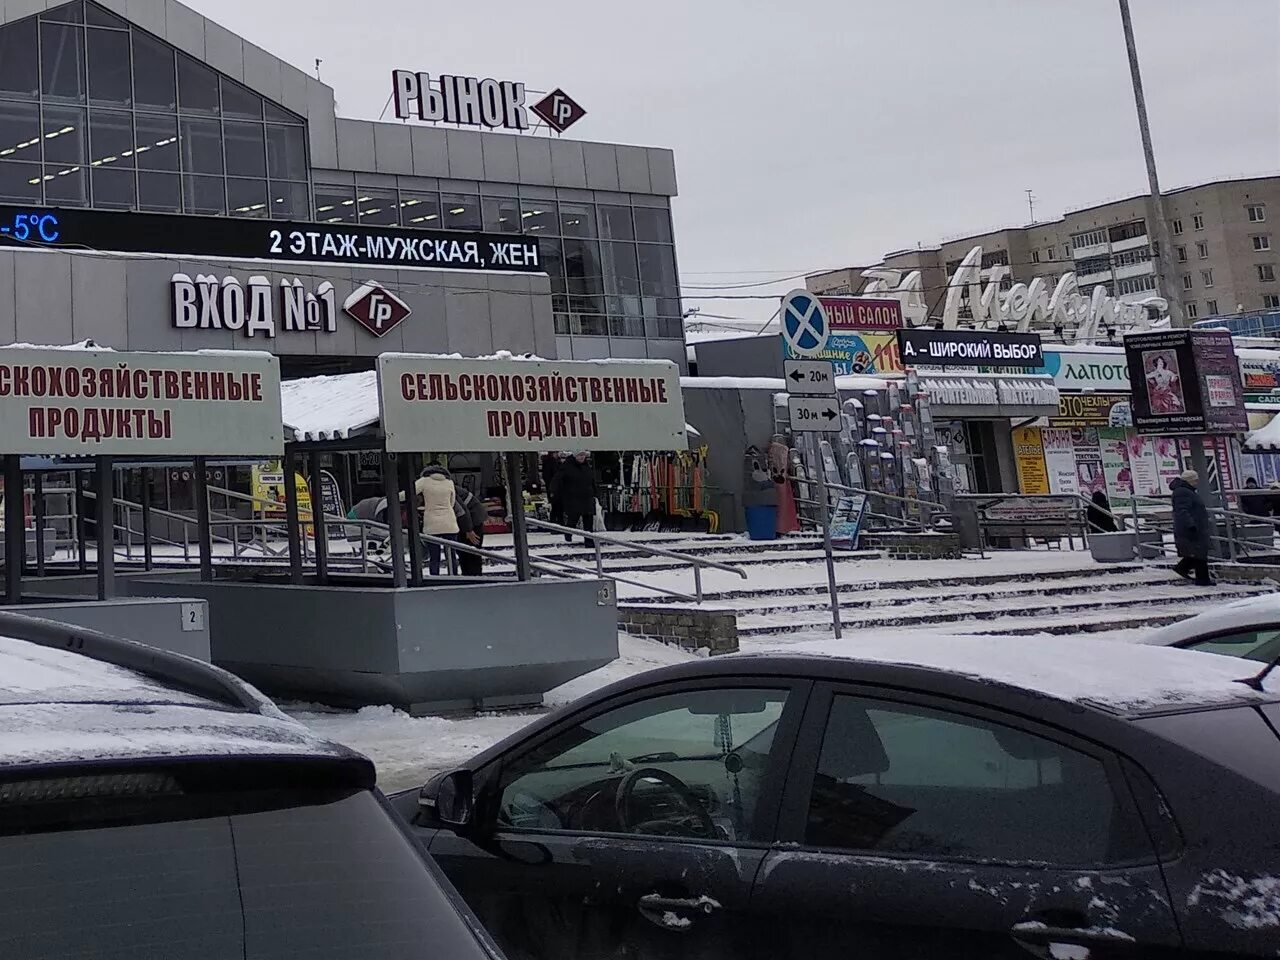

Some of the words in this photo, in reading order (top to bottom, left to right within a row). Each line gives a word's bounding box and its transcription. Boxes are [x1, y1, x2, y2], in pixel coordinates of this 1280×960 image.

[392, 70, 530, 130] РЫНОК
[269, 230, 283, 253] 2
[288, 232, 485, 267] ЭТАЖ-МУЖСКАЯ,
[489, 242, 539, 266] ЖЕН
[172, 276, 277, 338] ВХОД
[282, 280, 336, 333] №1
[828, 303, 855, 324] НЫЙ
[858, 306, 899, 325] САЛОН
[929, 340, 991, 359] ШИРОКИЙ
[994, 344, 1037, 359] ВЫБОР
[400, 371, 668, 403] СЕЛЬСКОХОЗЯЙСТВЕННЫЕ
[924, 382, 998, 405] ТРОИТЕЛЬНЫЕ
[28, 406, 172, 442] ПРОДУКТЫ
[486, 410, 599, 440] ПРОДУКТЫ
[189, 609, 196, 623] 2
